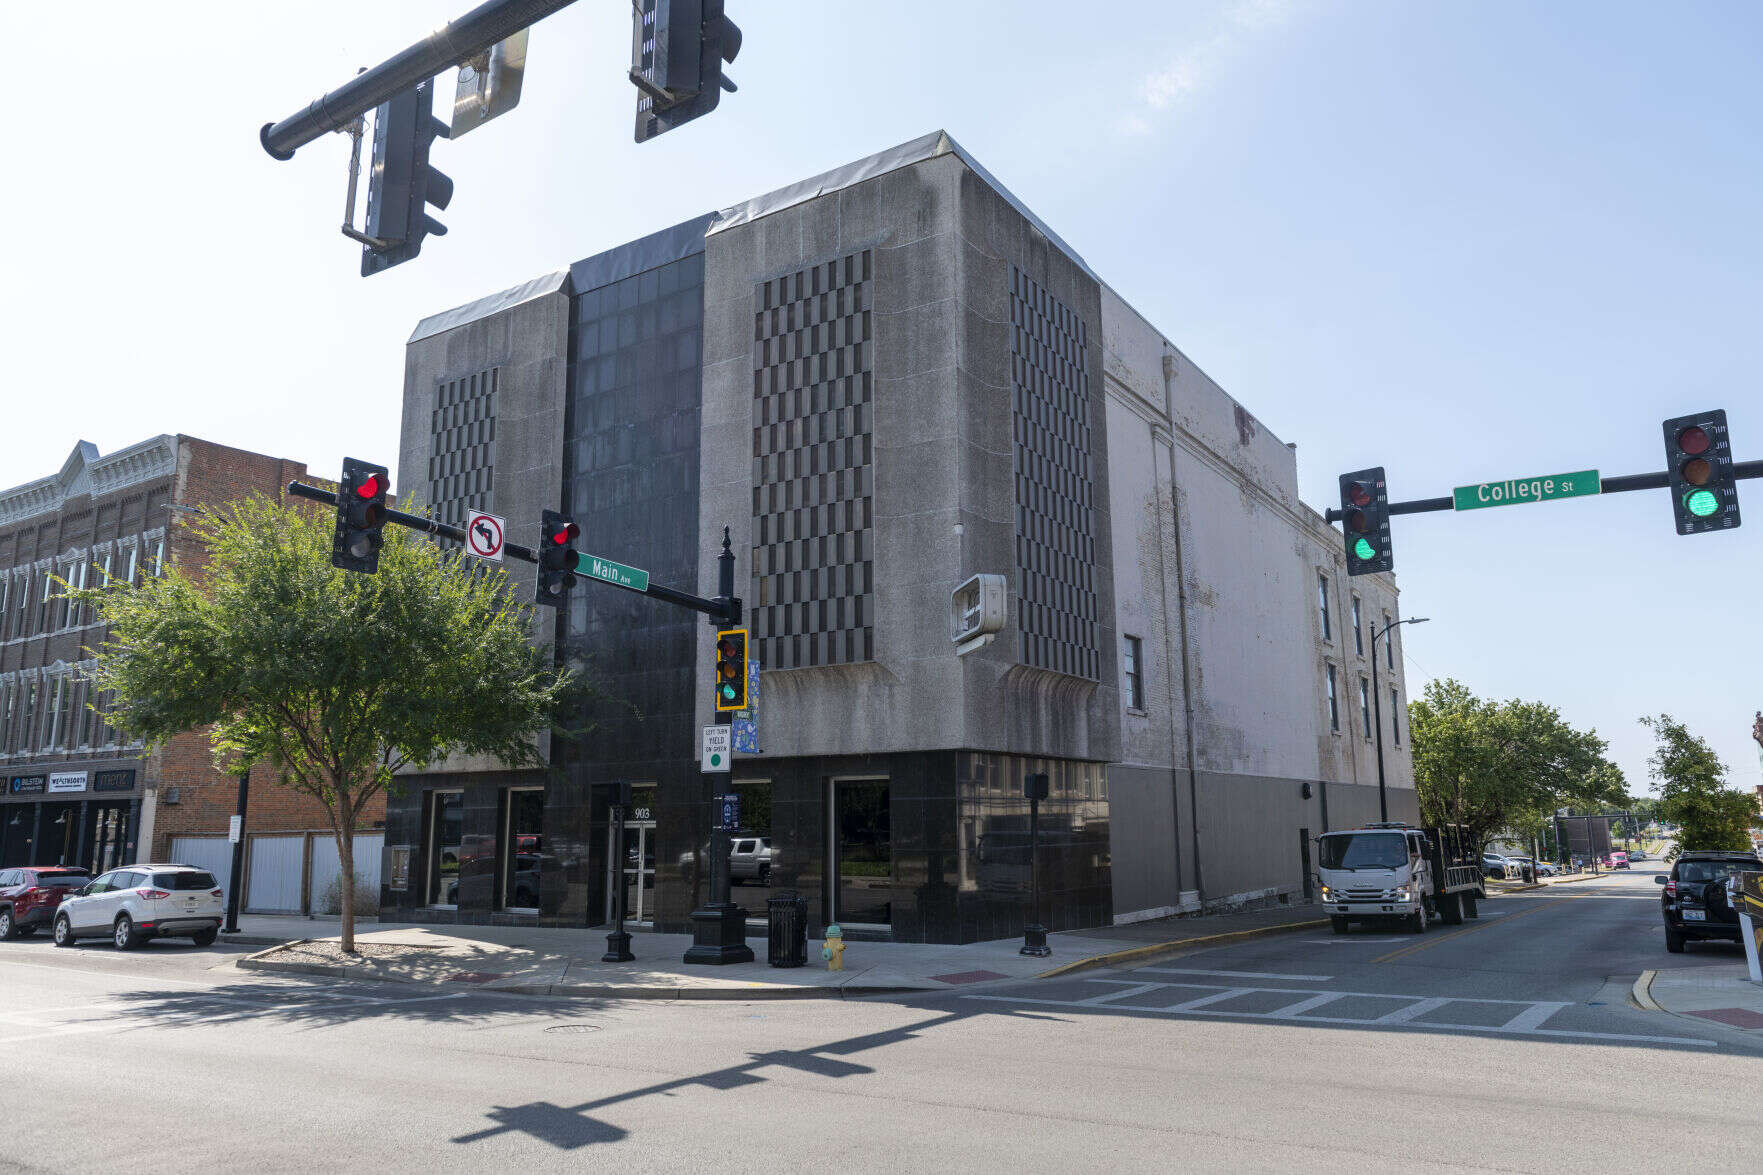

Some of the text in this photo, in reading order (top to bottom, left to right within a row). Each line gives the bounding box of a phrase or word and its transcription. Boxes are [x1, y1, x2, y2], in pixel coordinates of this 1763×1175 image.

[1477, 479, 1574, 502] College St
[592, 559, 631, 585] Main Ave
[709, 736, 725, 745] YIELD
[635, 807, 650, 819] 903
